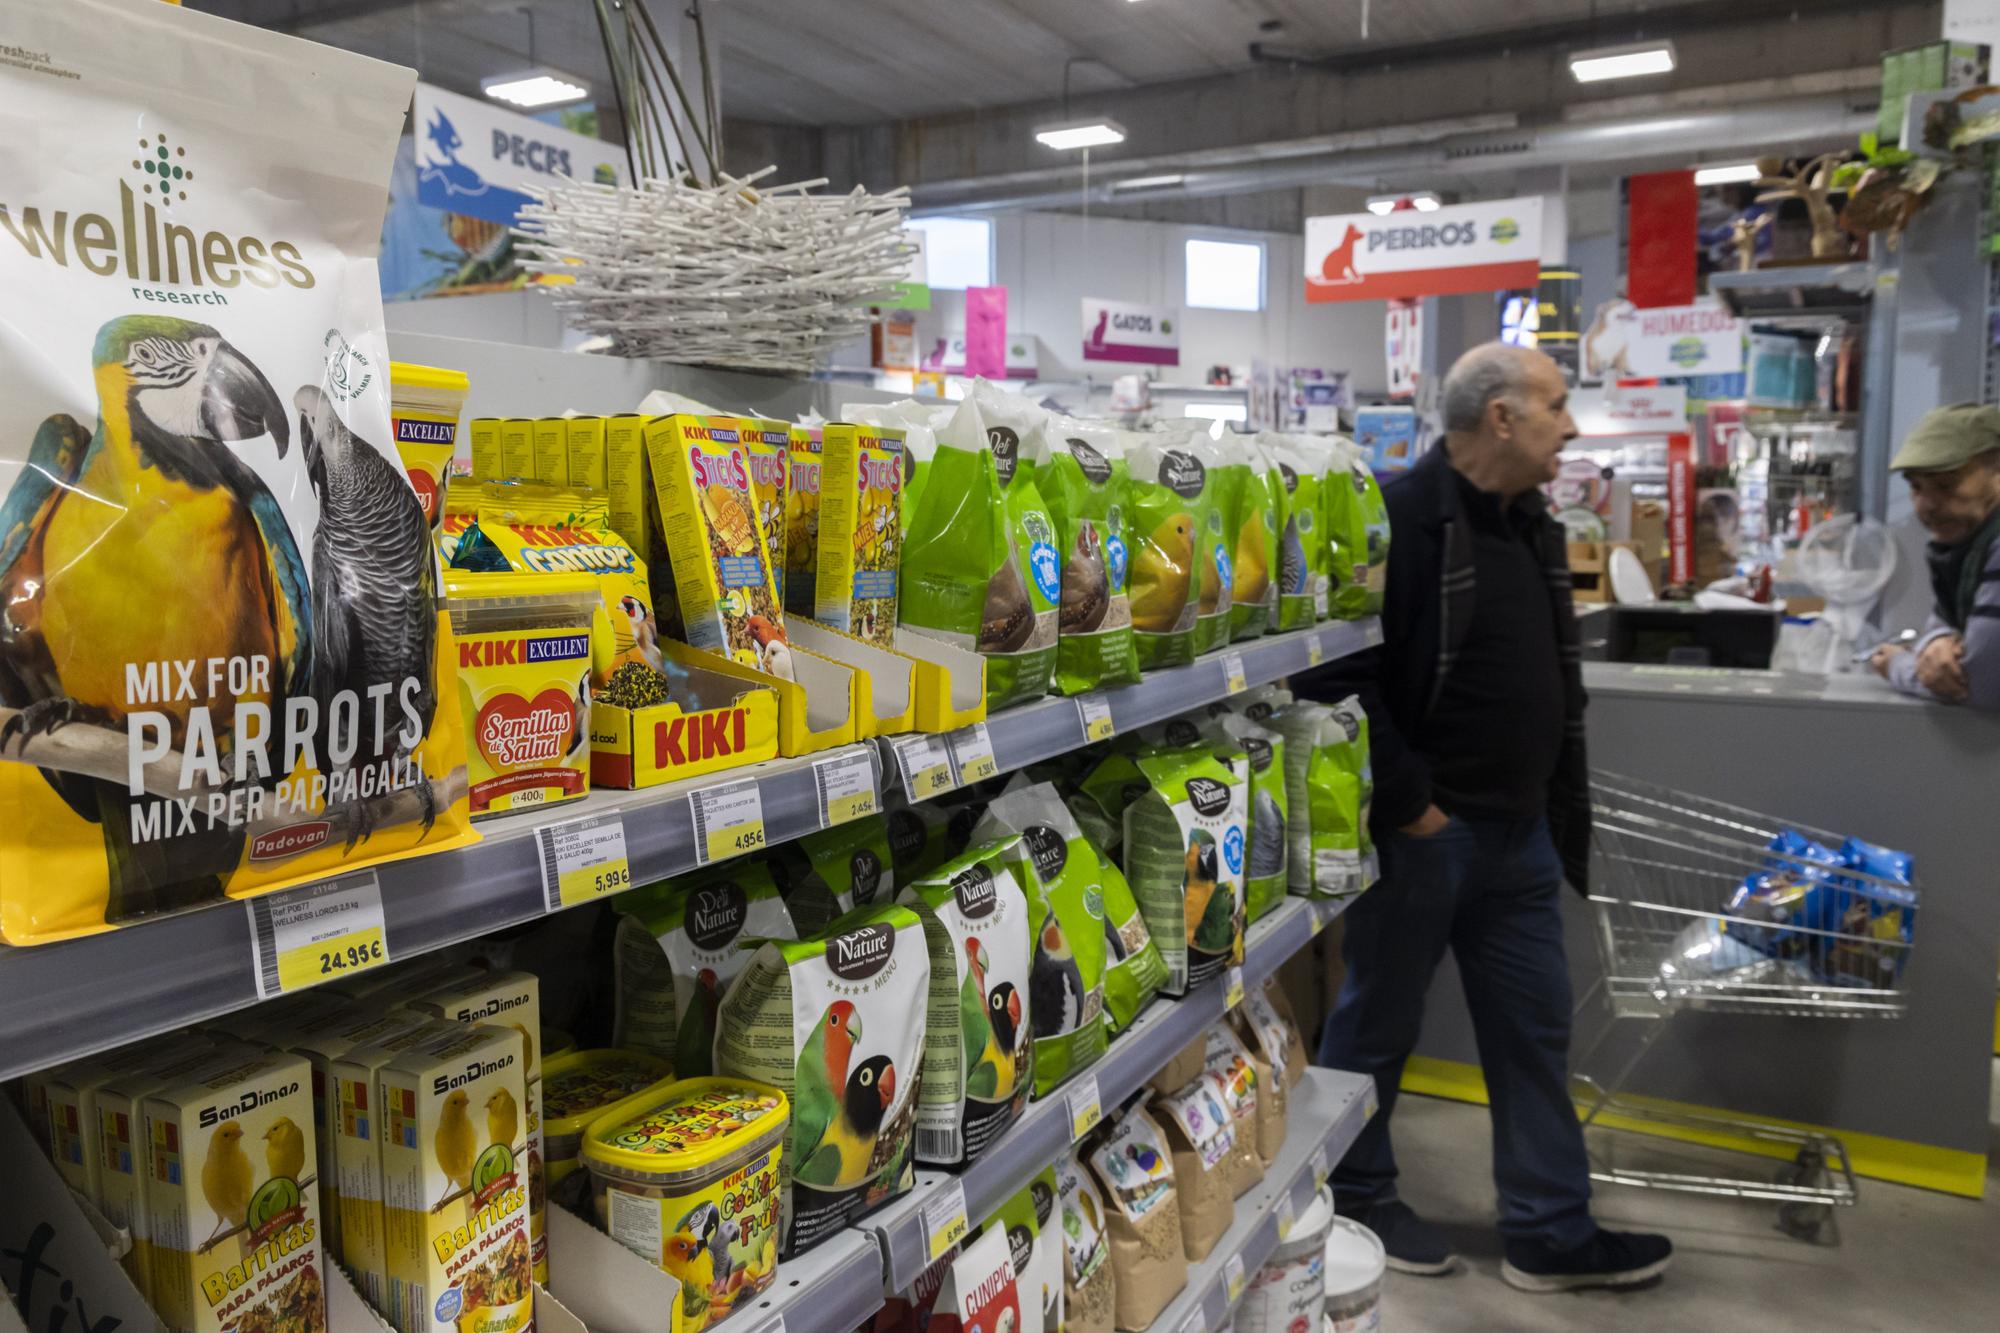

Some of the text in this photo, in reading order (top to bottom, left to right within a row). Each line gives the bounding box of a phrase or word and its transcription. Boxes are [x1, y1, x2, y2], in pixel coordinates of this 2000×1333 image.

[492, 129, 573, 178] PECES
[0, 178, 316, 290] wellness
[1368, 221, 1477, 252] PERROS
[132, 285, 228, 306] research
[1112, 313, 1153, 333] GATOS
[400, 422, 456, 441] EXCELLENT
[683, 426, 711, 440] KIKI
[790, 441, 811, 452] IKI
[858, 435, 880, 449] KIKI
[745, 448, 786, 489] TICKS
[509, 524, 602, 547] KIKI
[853, 521, 876, 550] MIEL
[459, 637, 588, 668] KIKI EXCELLENT
[126, 655, 271, 704] MIX FOR
[127, 676, 423, 797] PARROTS
[484, 709, 571, 742] Semillas
[599, 733, 617, 744] cool
[654, 708, 746, 770] KIKI
[489, 741, 501, 754] de
[499, 734, 560, 766] Salud
[130, 752, 424, 844] MIX PER PAPPAGALLI
[255, 828, 326, 856] Padovan
[735, 829, 764, 849] 4,95€
[698, 887, 729, 914] Deli
[273, 911, 314, 928] WELLNESS
[315, 905, 339, 918] LOROS
[694, 907, 738, 935] Nature
[837, 933, 887, 964] Nature
[874, 959, 897, 990] MENU
[433, 1184, 526, 1265] Barritas
[445, 1214, 525, 1279] PARA PÁJAROS
[201, 1219, 316, 1307] Barritas
[217, 1249, 315, 1322] PARA PÁJAROS
[965, 1260, 1012, 1318] CUNIPIC
